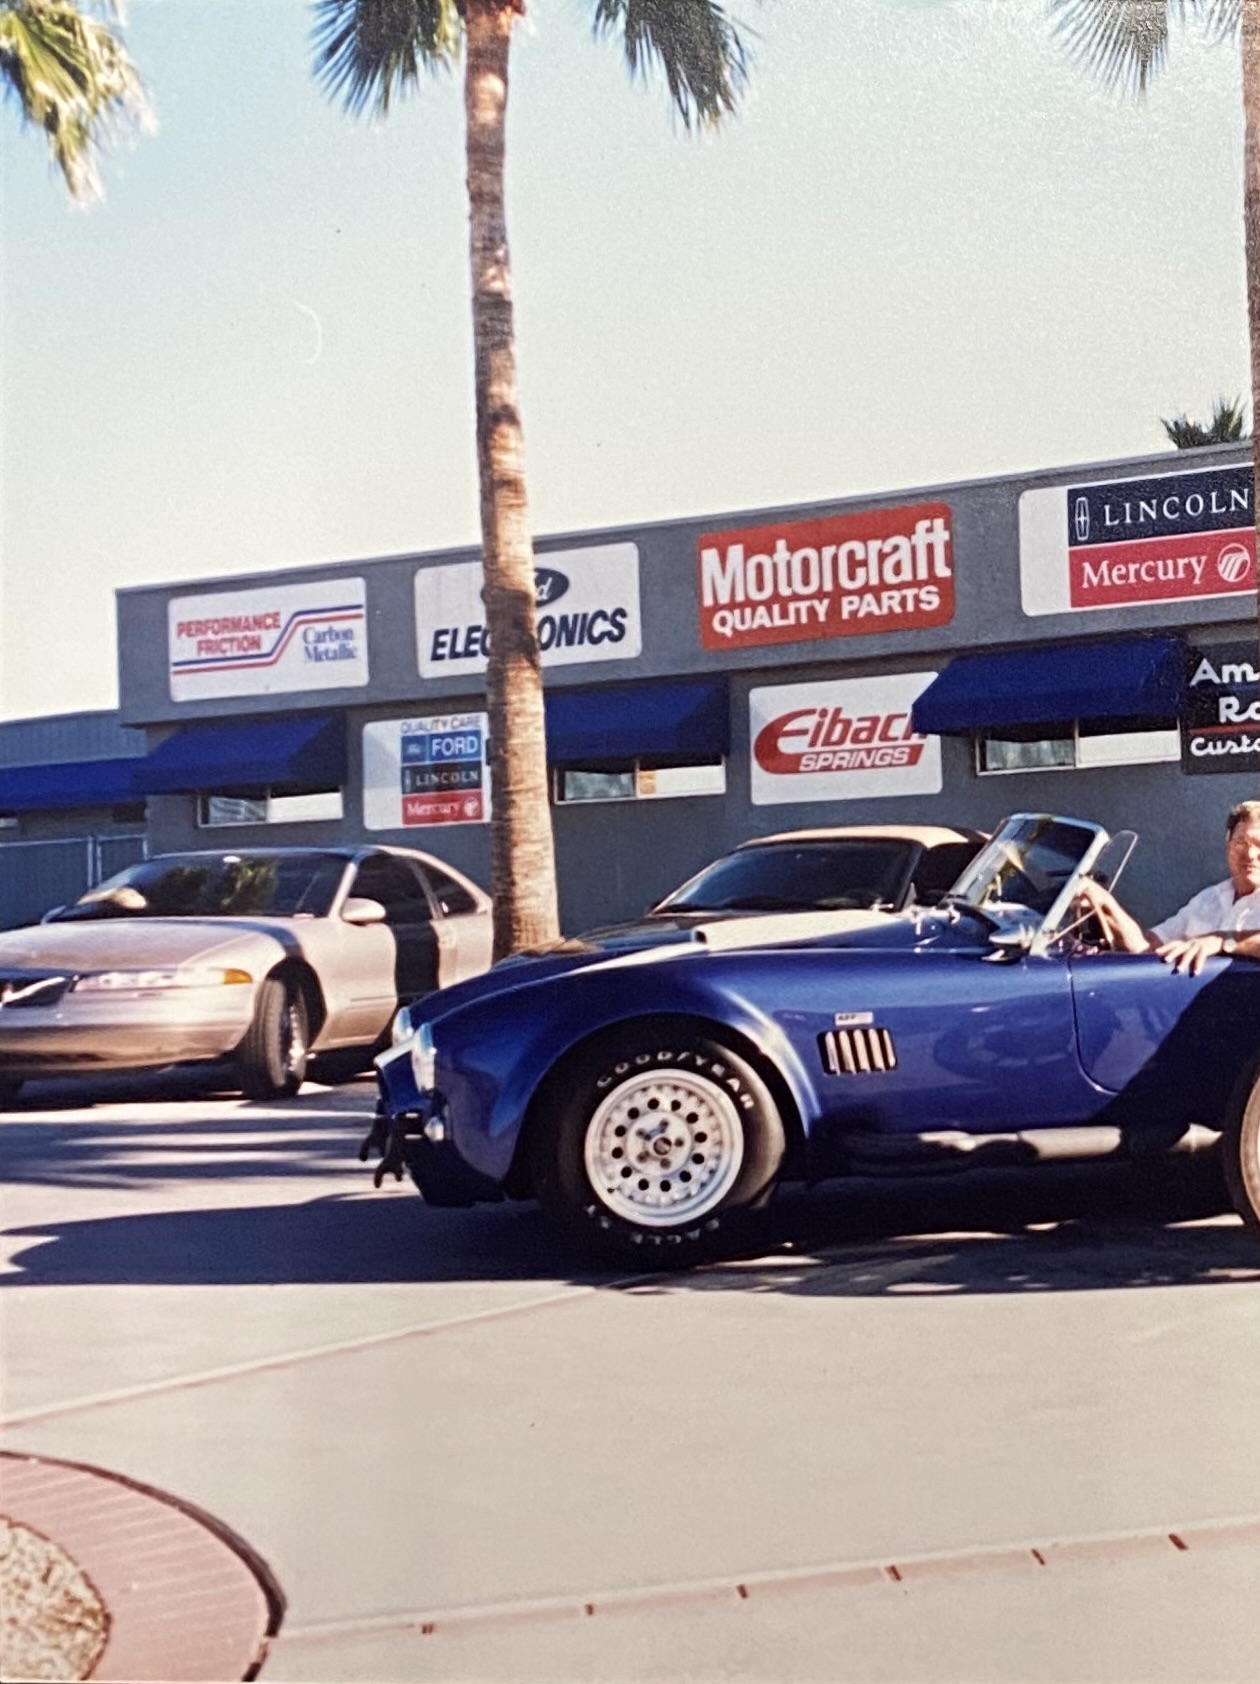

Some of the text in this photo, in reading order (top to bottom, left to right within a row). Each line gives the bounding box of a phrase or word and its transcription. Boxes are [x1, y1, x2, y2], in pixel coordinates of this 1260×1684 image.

[1103, 487, 1250, 527] LINCOLN
[701, 518, 952, 607] Motorcraft
[1082, 555, 1208, 589] Mercury
[712, 585, 941, 638] QUALITY PARTS
[177, 611, 281, 638] PERFORMANCE
[303, 626, 354, 645] Carbon
[430, 606, 628, 662] ELEONICS
[197, 635, 261, 656] FRICTION
[303, 644, 357, 663] Metallic
[401, 715, 480, 734] QUALITY CARE
[431, 736, 479, 757] FORD
[799, 746, 911, 772] SPRINGS
[416, 770, 479, 786] LINCOLN
[406, 801, 461, 817] Mercury
